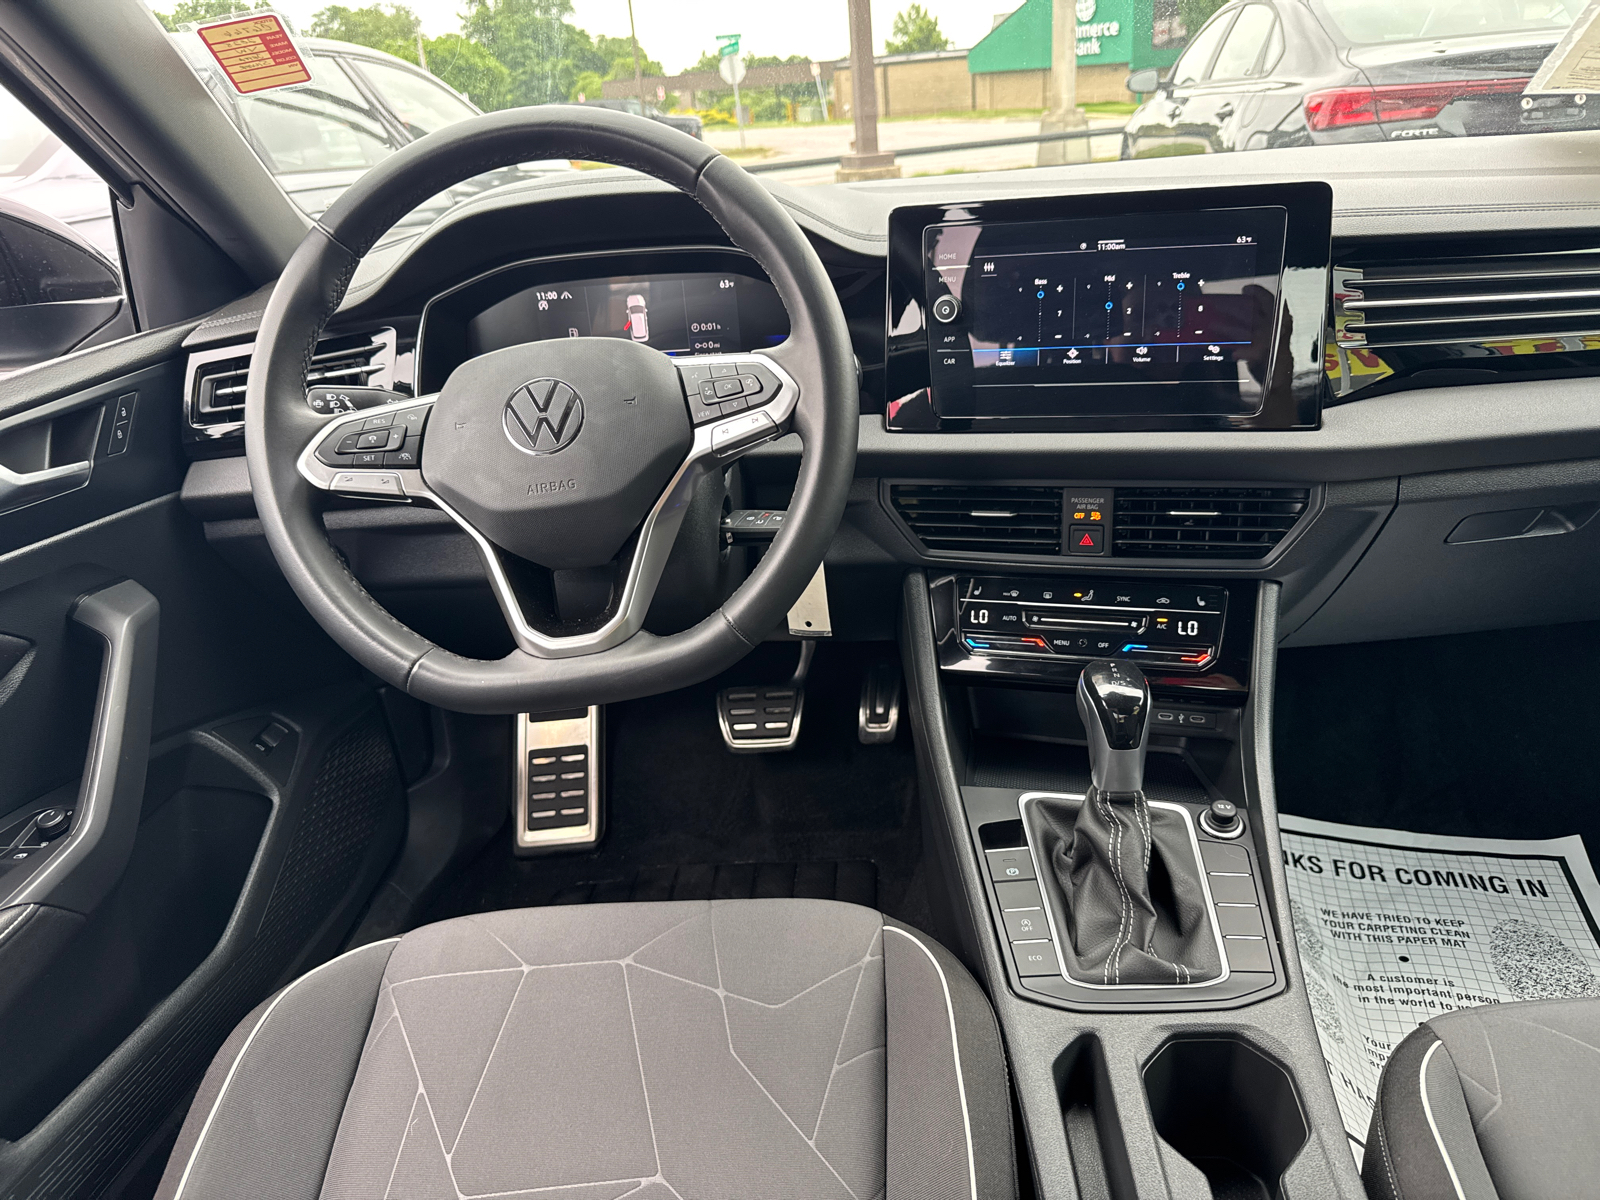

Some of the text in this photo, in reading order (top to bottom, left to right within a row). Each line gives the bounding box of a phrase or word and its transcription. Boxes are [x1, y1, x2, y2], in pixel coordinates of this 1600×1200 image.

[1075, 38, 1101, 56] ank
[1391, 127, 1439, 138] FORTE
[1097, 243, 1125, 251] 11:00am
[939, 253, 957, 261] HOME
[1034, 278, 1048, 286] Bass
[1172, 272, 1191, 280] Treble
[536, 291, 558, 301] 11:00
[1057, 309, 1063, 317] 7
[1126, 307, 1132, 315] 2
[700, 322, 716, 331] 0:01
[1203, 354, 1224, 362] Settings
[697, 410, 711, 418] VIEW
[527, 478, 577, 496] AIRBAG
[970, 609, 989, 624] LO
[1178, 620, 1199, 636] LO
[1053, 639, 1070, 647] MENU
[1332, 858, 1387, 883] FOR
[1395, 867, 1510, 895] COMING
[1515, 878, 1550, 898] IN
[1320, 907, 1465, 928] WE HAVE TRIED TO KEEP
[1321, 917, 1471, 939] YOUR CARPETING CLEAN
[1330, 929, 1468, 949] WITH THIS PAPER MAT
[1367, 973, 1455, 988] A customer is
[1353, 984, 1385, 993] most
[1389, 984, 1453, 999] important
[1456, 992, 1501, 1006] person
[1357, 994, 1370, 1004] in
[1374, 995, 1395, 1005] the
[1399, 998, 1436, 1009] world
[1439, 1000, 1453, 1011] to
[1362, 1033, 1392, 1051] Your
